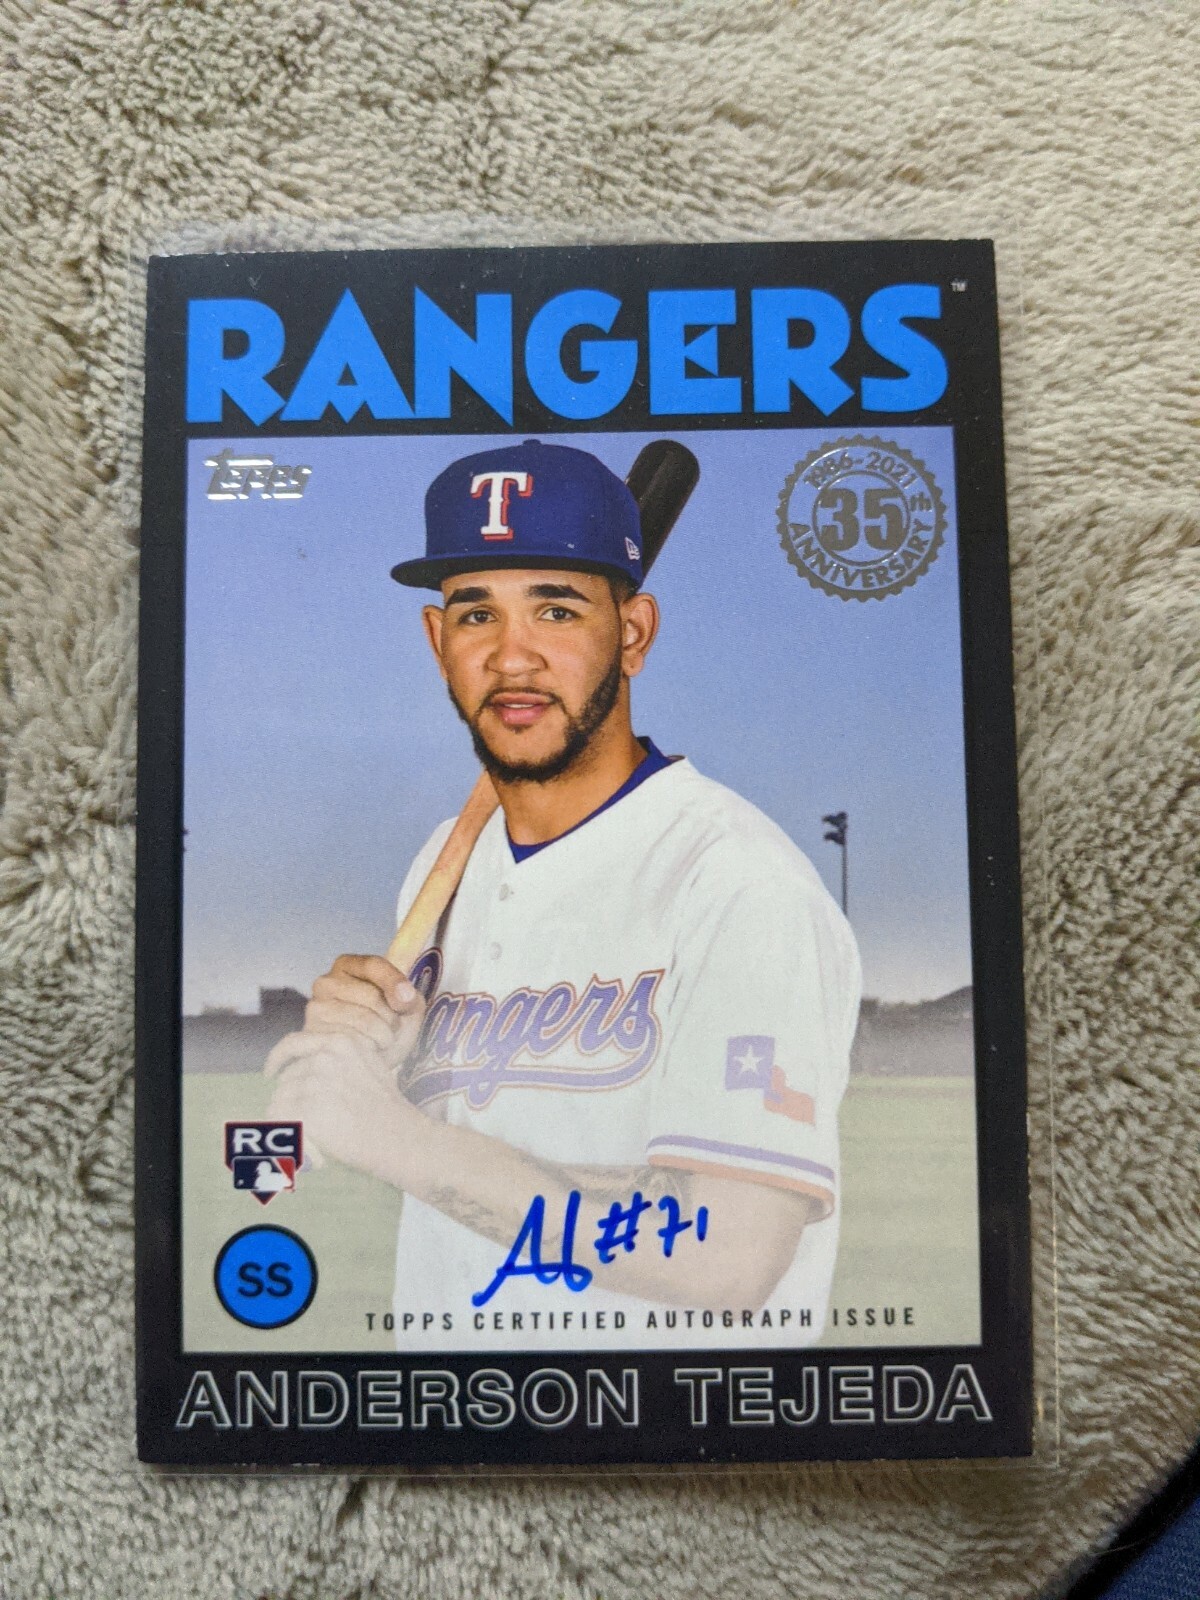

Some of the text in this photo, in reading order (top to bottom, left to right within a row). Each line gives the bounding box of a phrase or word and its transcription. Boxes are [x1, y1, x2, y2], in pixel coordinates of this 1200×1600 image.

[186, 284, 949, 426] RANGERS
[803, 451, 917, 490] 1986-2021
[470, 471, 534, 541] T
[787, 516, 933, 590] ANNIVERSARY
[233, 1127, 295, 1154] RC
[237, 1261, 294, 1298] SS
[365, 1306, 916, 1332] TOPPS CERTIFIED AUTOGRAPH ISSUE
[176, 1362, 993, 1432] ANDERSON TEJEDA
